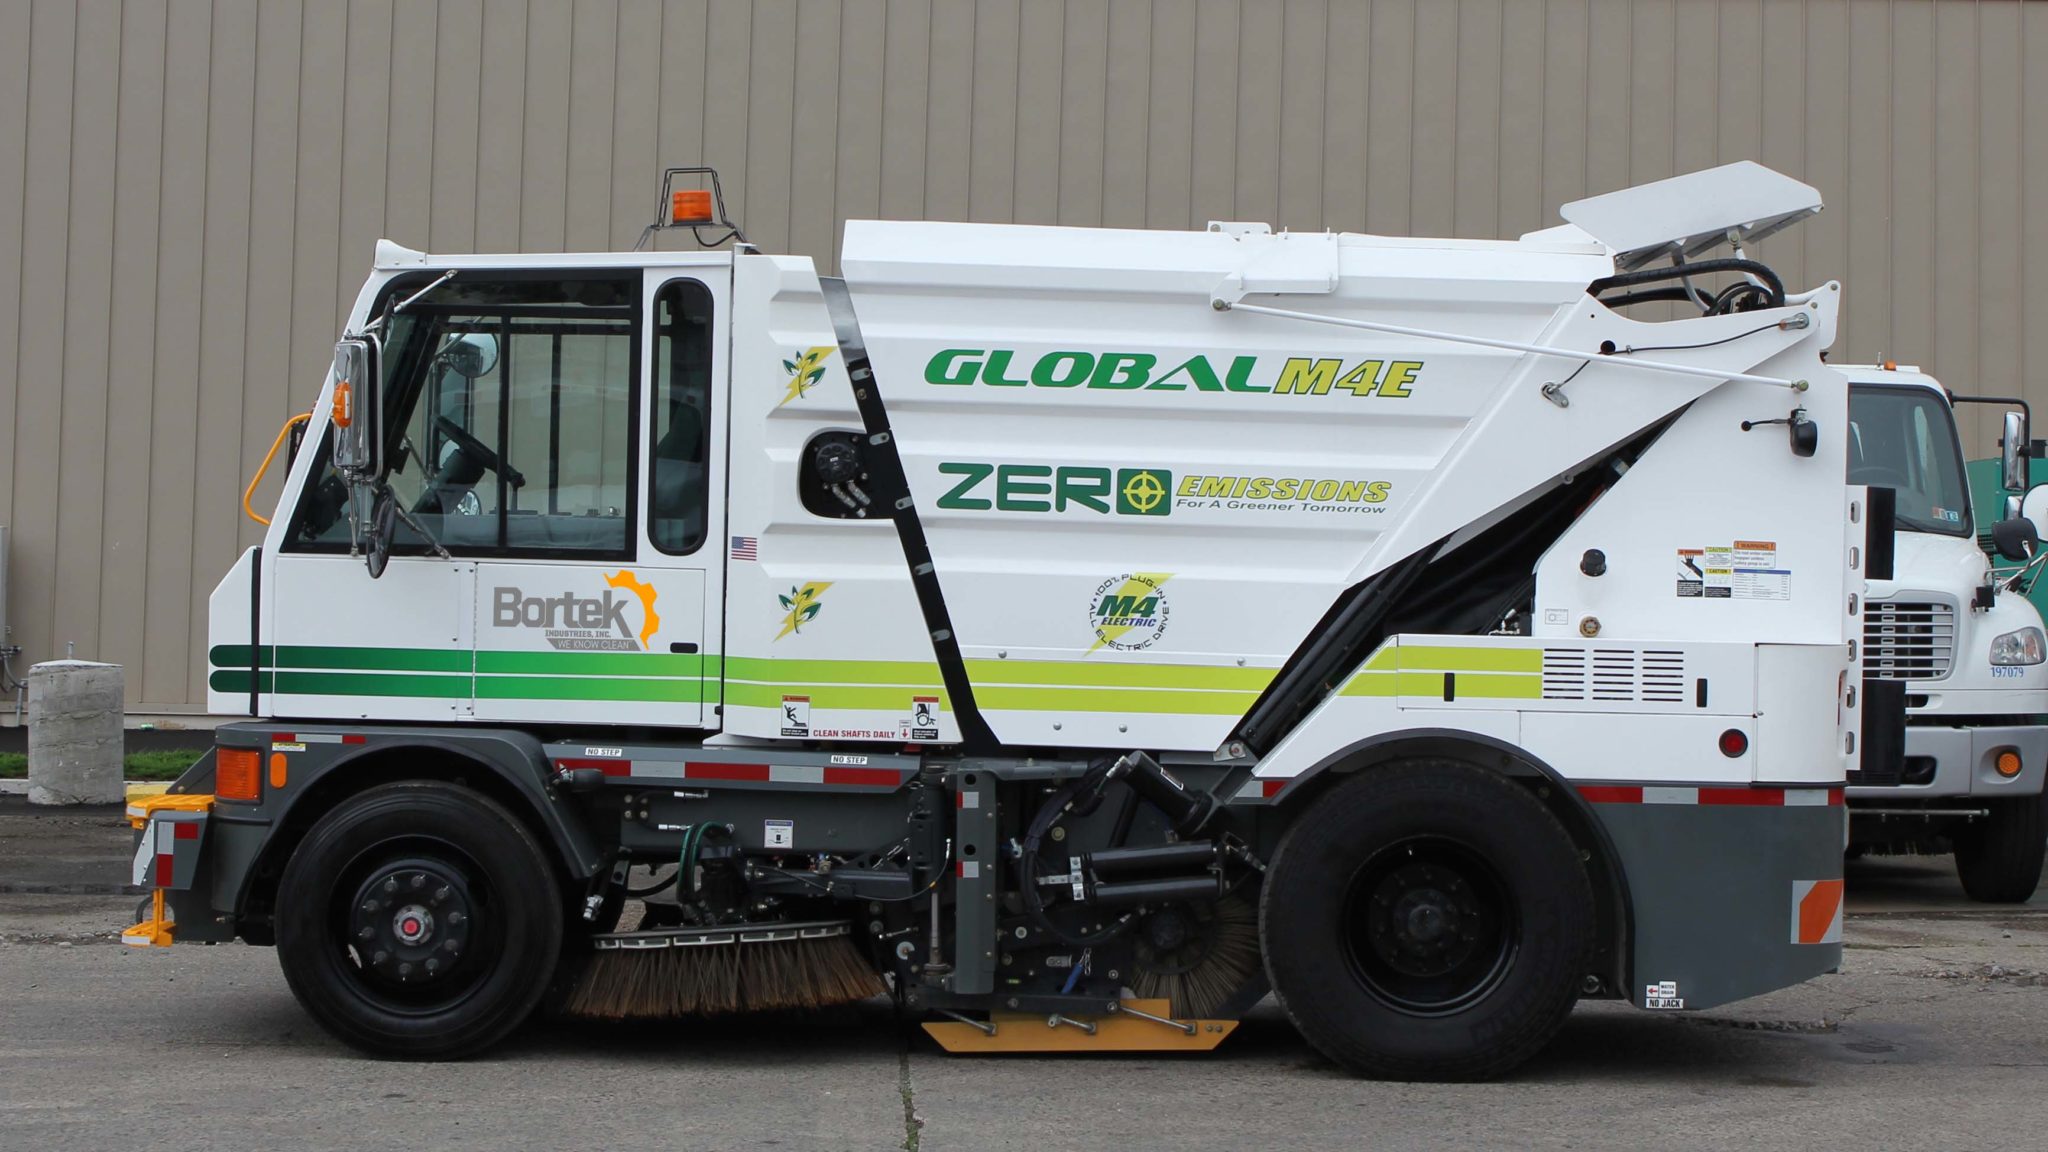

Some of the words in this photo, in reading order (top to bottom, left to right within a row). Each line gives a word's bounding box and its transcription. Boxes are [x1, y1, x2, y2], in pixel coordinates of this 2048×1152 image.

[924, 348, 1272, 394] GLOBAL
[1272, 357, 1424, 398] M4E
[1176, 474, 1392, 503] EMISSIONS
[1176, 498, 1205, 510] For
[1210, 499, 1222, 511] A
[1225, 500, 1295, 512] Greener
[1300, 501, 1387, 514] Tomorrow
[1095, 577, 1119, 596] 100%
[1121, 574, 1166, 599] PLUG-IN
[1096, 595, 1159, 618] M4
[493, 587, 633, 638] Bortek
[1089, 603, 1097, 628] ALL
[1096, 629, 1152, 651] ELECTRIC
[1152, 606, 1169, 640] DRIVE
[1101, 617, 1157, 627] ELECTRIC
[545, 629, 594, 638] INDUSTRIES,
[595, 630, 611, 638] INC.
[557, 639, 572, 649] WE
[573, 640, 600, 649] KNOW
[601, 640, 629, 650] CLEAN
[1990, 667, 2024, 678] 197079
[813, 729, 839, 737] CLEAN
[841, 729, 871, 738] SHAFTS
[873, 731, 896, 739] DAILY
[587, 748, 598, 756] NO
[600, 749, 620, 757] STEP
[833, 755, 845, 763] NO
[846, 756, 865, 764] STEP
[1649, 999, 1659, 1008] NO
[1662, 999, 1680, 1008] JACK
